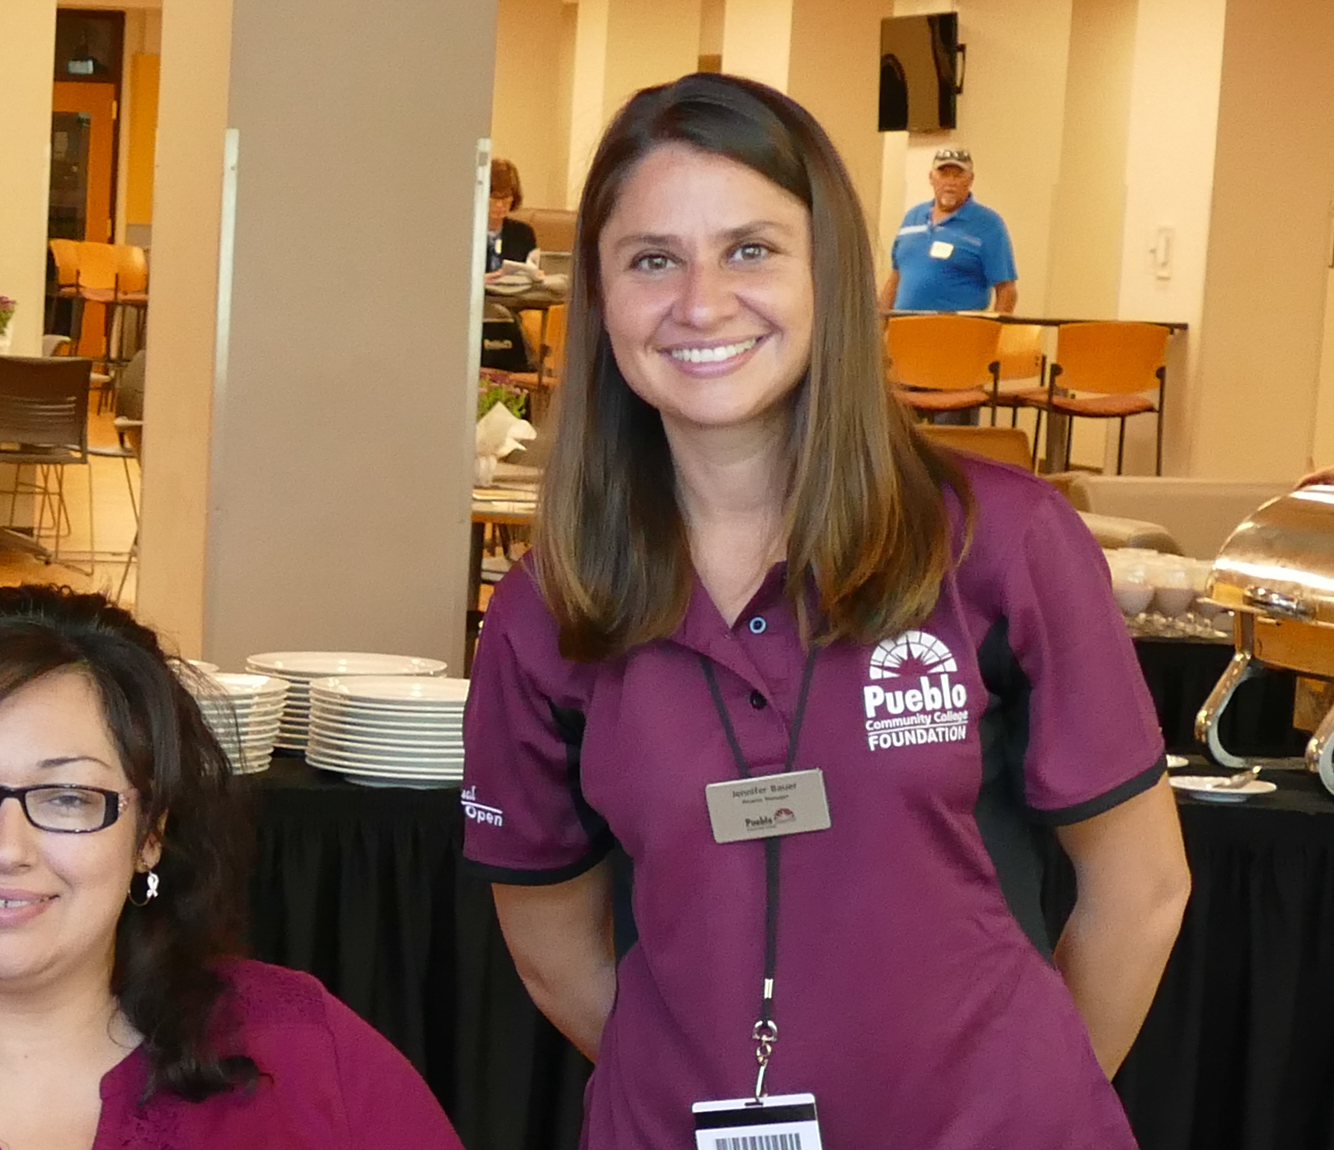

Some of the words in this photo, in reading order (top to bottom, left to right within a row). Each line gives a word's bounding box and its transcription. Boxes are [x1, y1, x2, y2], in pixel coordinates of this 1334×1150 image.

[863, 673, 968, 718] Pueblo
[865, 714, 932, 731] Community
[933, 710, 969, 723] College
[868, 725, 967, 752] FOUNDATION
[465, 805, 504, 827] Open
